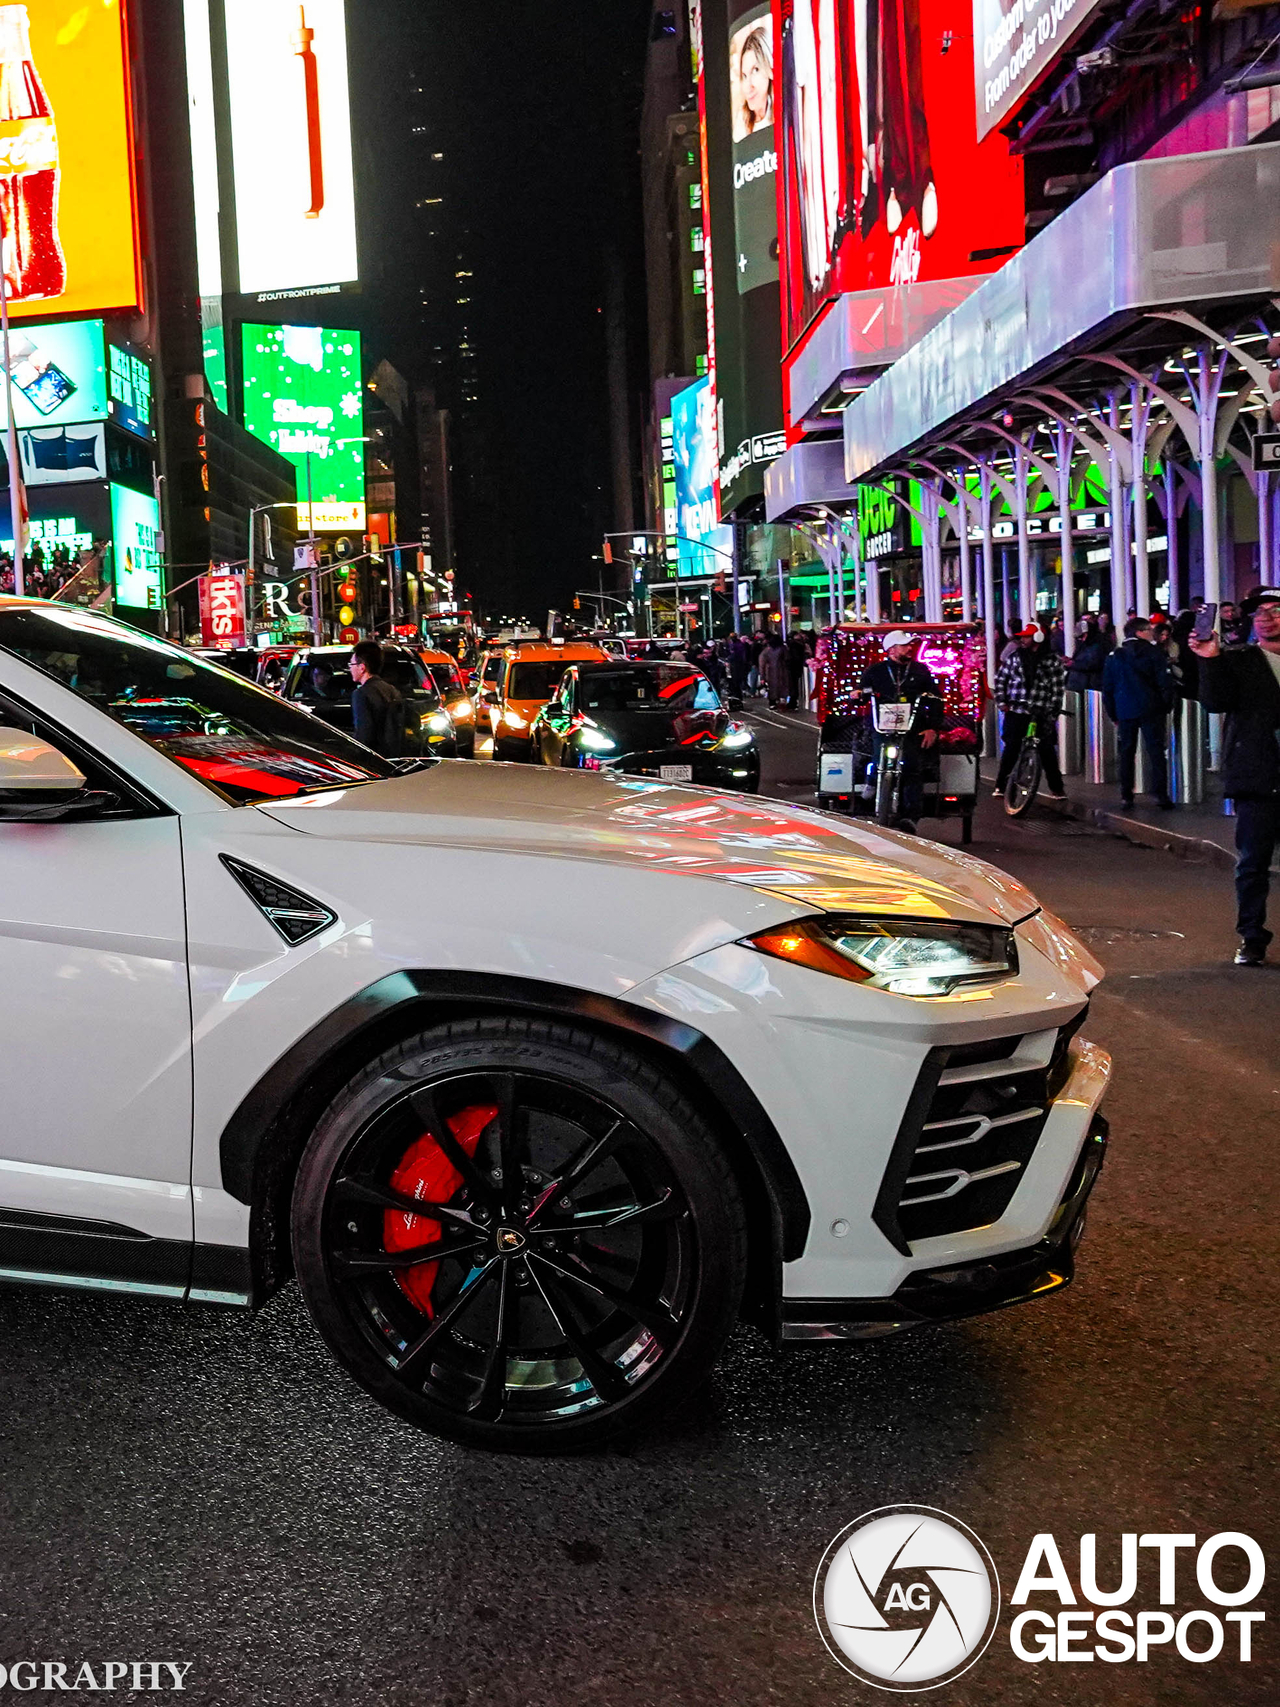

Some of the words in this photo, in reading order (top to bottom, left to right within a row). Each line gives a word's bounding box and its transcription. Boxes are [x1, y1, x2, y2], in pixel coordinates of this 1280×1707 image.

[733, 150, 778, 189] Create
[257, 285, 341, 302] #OUTFRONTPRIME
[315, 514, 349, 522] store
[967, 512, 1111, 540] SOCCE
[866, 531, 892, 559] SOCCER
[209, 578, 237, 636] tkts
[261, 582, 301, 618] R
